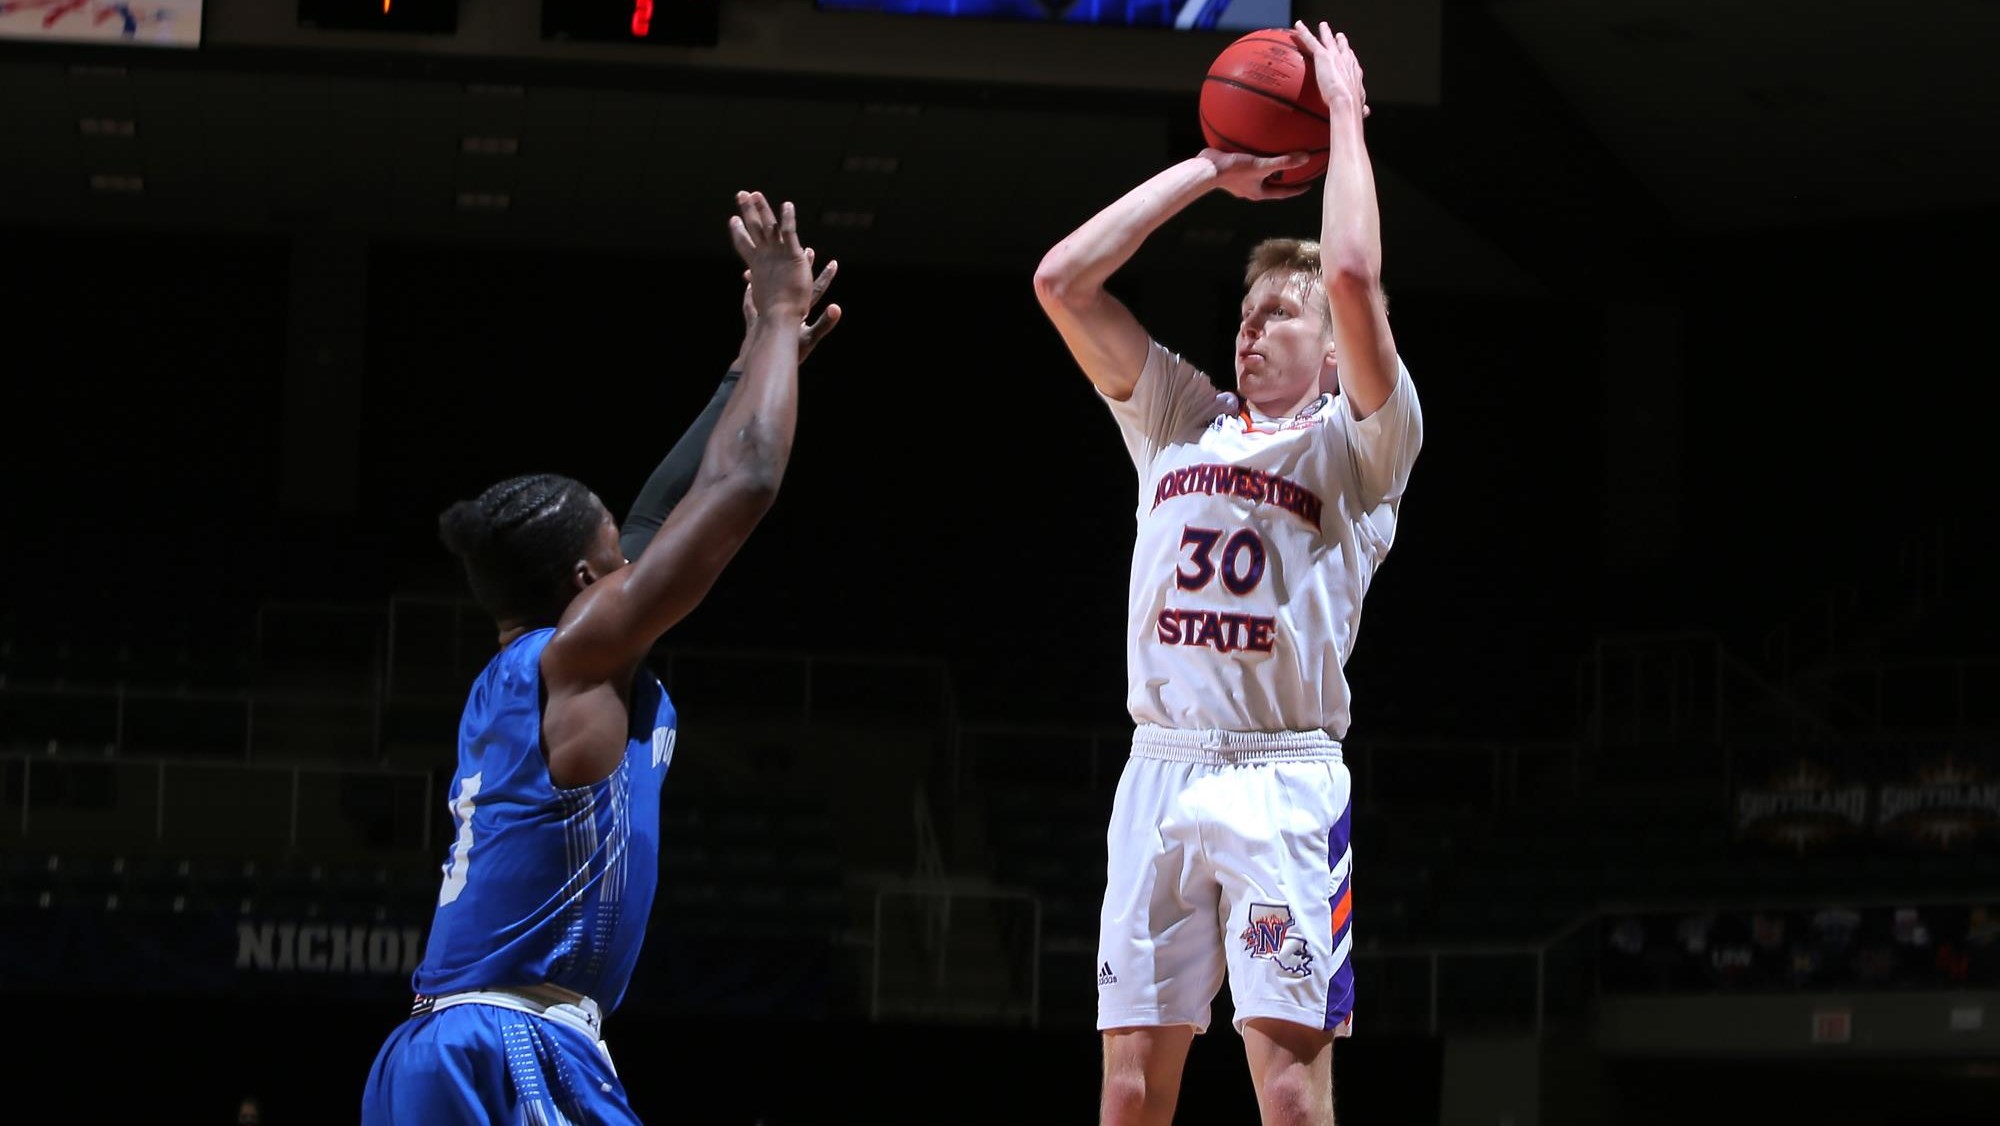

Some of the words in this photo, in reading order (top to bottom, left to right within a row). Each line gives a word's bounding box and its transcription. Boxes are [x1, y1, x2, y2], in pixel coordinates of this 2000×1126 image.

[1149, 463, 1323, 536] NORTHWESTERN
[1176, 525, 1266, 596] 30
[1156, 608, 1276, 653] STATE
[1738, 782, 1867, 829] SOUTHLAND
[1258, 923, 1283, 952] N
